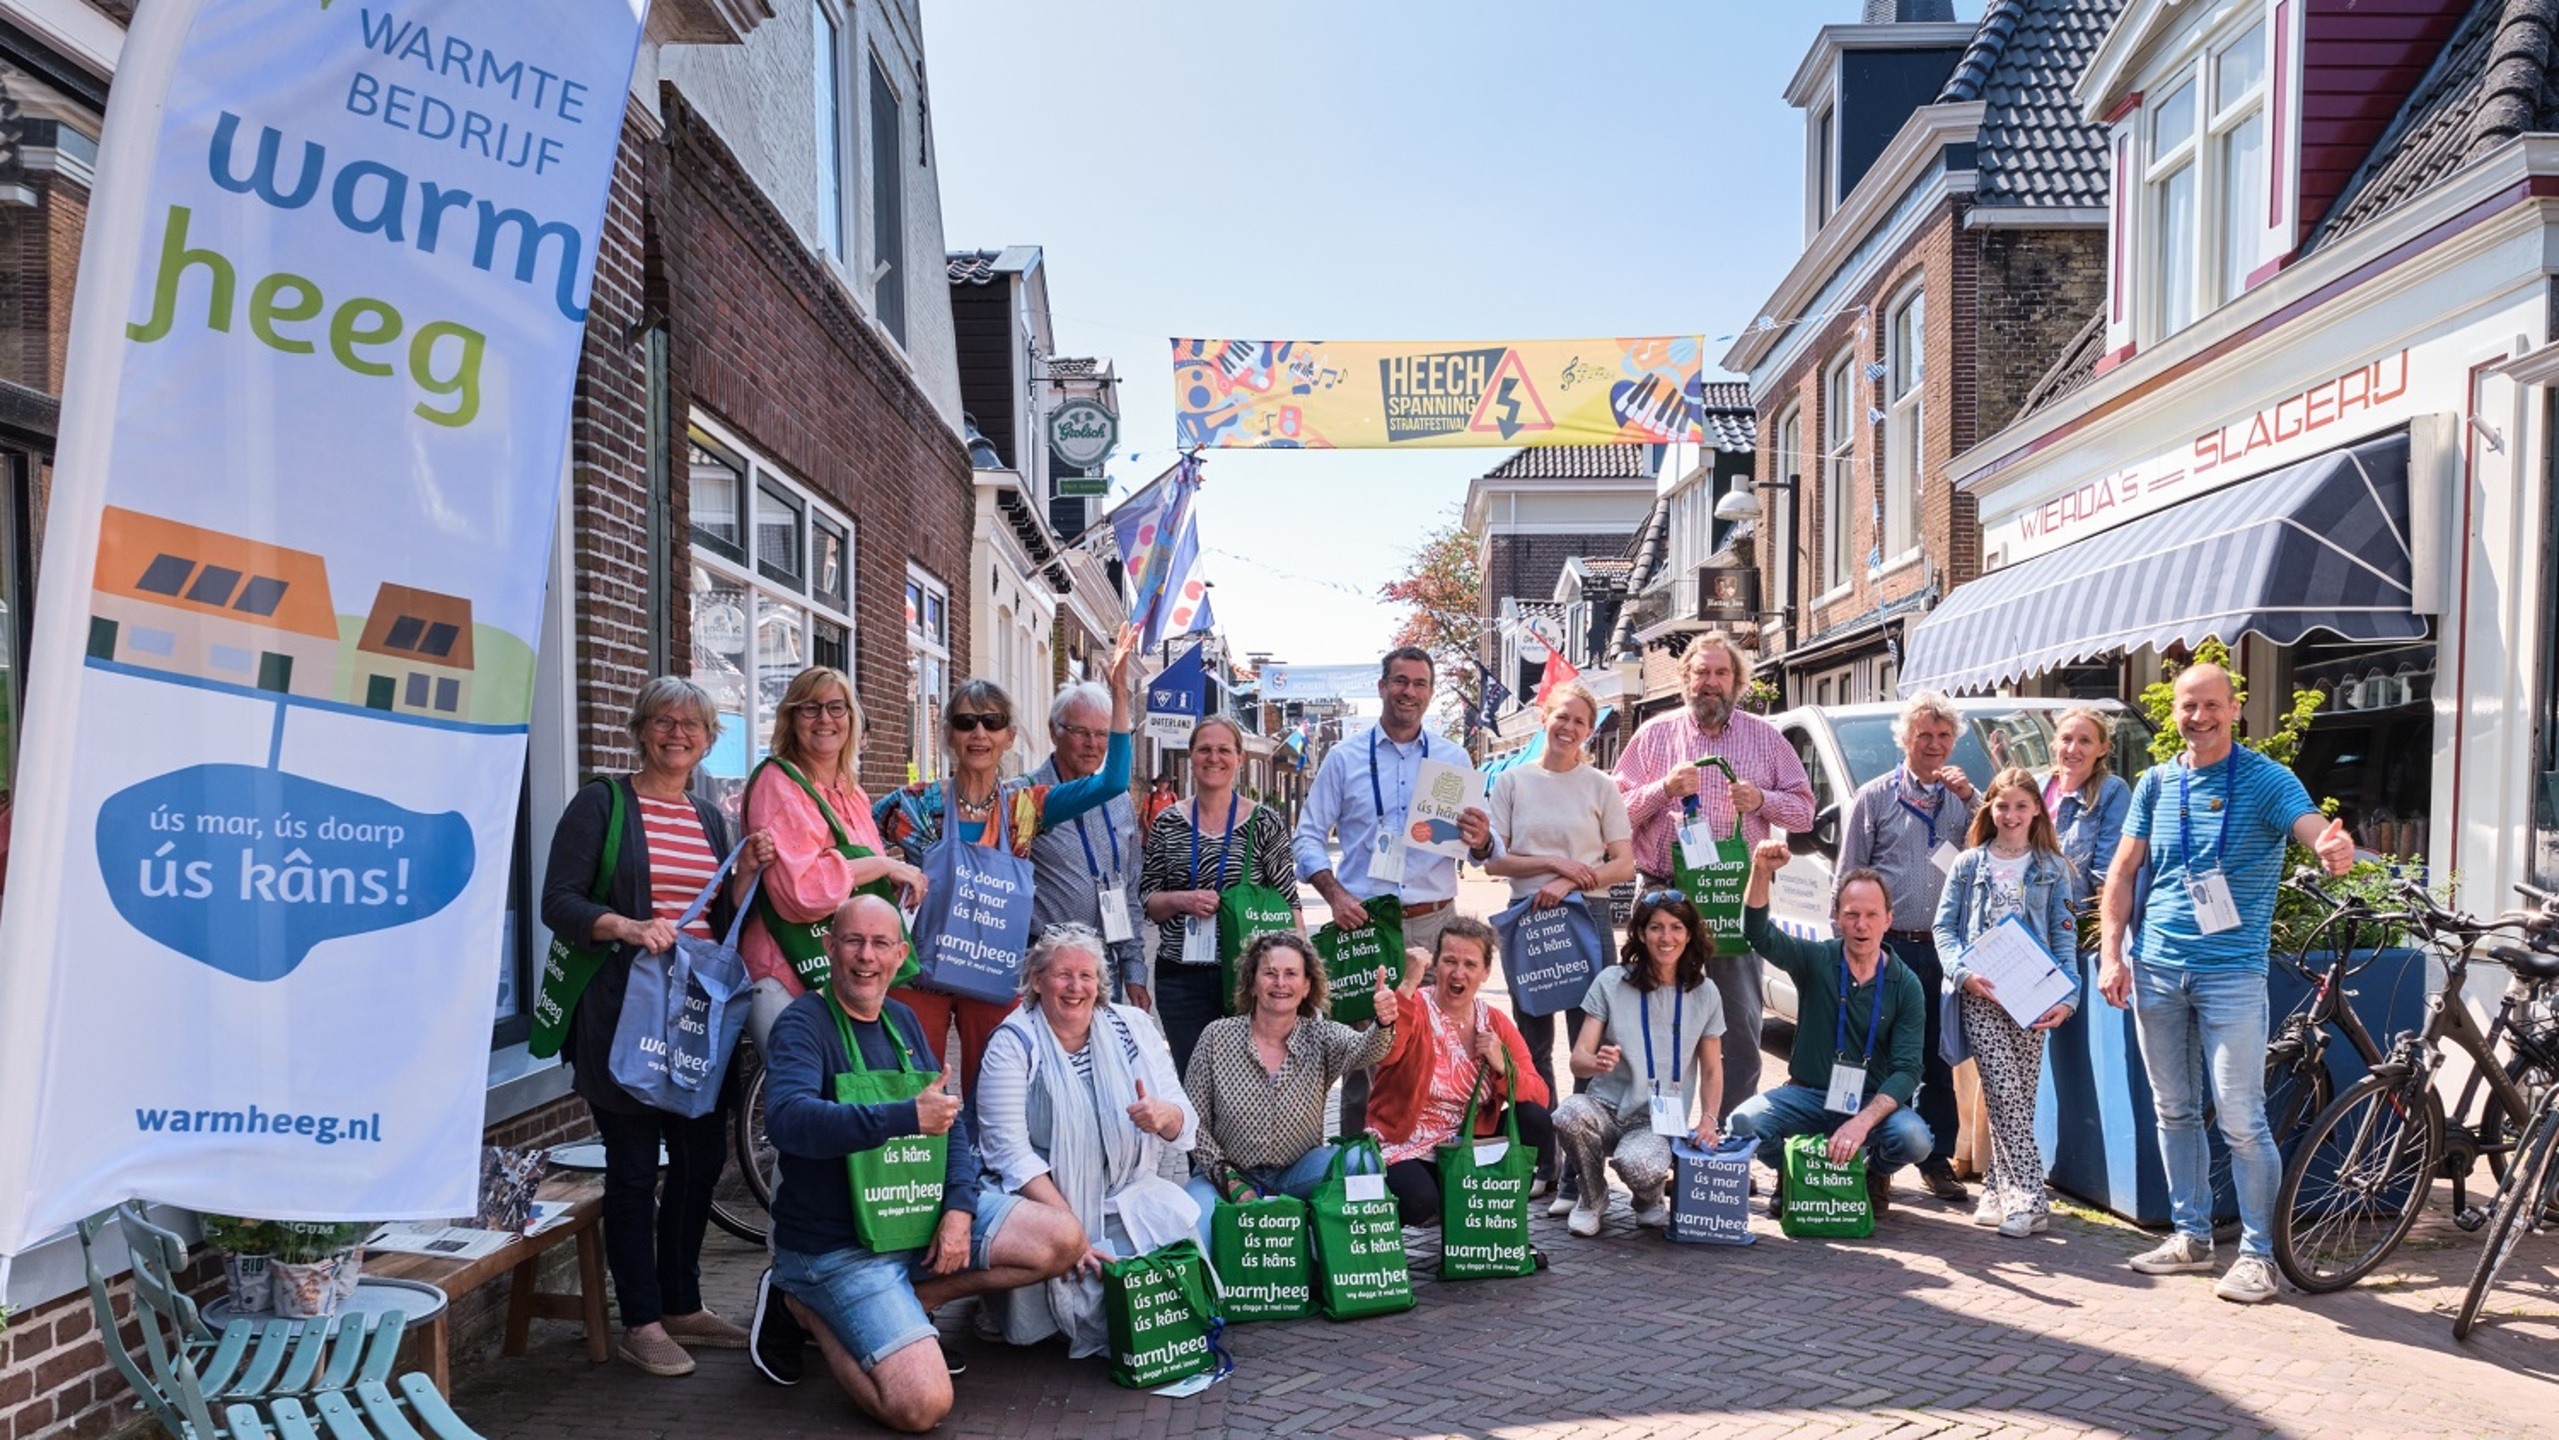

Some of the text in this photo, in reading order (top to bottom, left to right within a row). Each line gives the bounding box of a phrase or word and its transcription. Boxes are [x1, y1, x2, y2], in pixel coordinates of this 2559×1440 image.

[361, 8, 588, 124] WARMTE
[346, 72, 564, 175] BEDRIJF
[208, 110, 589, 322] warm
[125, 204, 487, 428] heeg
[1389, 355, 1486, 395] HEECH
[1388, 396, 1477, 416] SPANNING
[2193, 348, 2409, 474] SLAGERIJ
[1057, 421, 1107, 441] Grolsch
[1417, 799, 1432, 815] ús
[150, 803, 405, 850] ús mar, ús doarp
[139, 840, 410, 906] ús kâns!
[956, 864, 1016, 893] ús doarp
[1697, 875, 1739, 887] ús mar
[959, 883, 1008, 910] ús mar
[1695, 891, 1740, 904] ús kâns
[953, 903, 1007, 930] ús kâns
[1245, 907, 1292, 923] ús doarp
[1534, 907, 1568, 922] doarp
[810, 923, 829, 939] ús
[1337, 927, 1376, 945] ús mar
[1526, 923, 1566, 941] ús mar
[1337, 942, 1381, 962] ús kâns
[1528, 938, 1572, 957] ús kâns
[1516, 959, 1589, 986] warmheeg
[136, 1104, 382, 1145] warmheeg.nl
[884, 1145, 931, 1164] ús kâns
[1806, 1157, 1821, 1169] ús
[1708, 1158, 1746, 1174] doarp
[1463, 1175, 1521, 1193] ús doarp
[1694, 1172, 1740, 1189] ús mar
[1805, 1171, 1853, 1187] ús kâns
[864, 1179, 943, 1204] warmheeg
[1691, 1187, 1740, 1206] ús kâns
[1342, 1202, 1359, 1216] ús
[1468, 1194, 1516, 1210] ús mar
[1789, 1199, 1867, 1216] warmheeg
[1238, 1212, 1301, 1231] ús doarp
[1350, 1220, 1395, 1234] ús mar
[1465, 1213, 1518, 1229] ús kâns
[1245, 1233, 1295, 1248] ús mar
[1350, 1238, 1401, 1255] ús kâns
[241, 1258, 264, 1272] BIO
[1241, 1252, 1296, 1268] ús kâns
[1124, 1263, 1187, 1289] ús dop
[1134, 1293, 1151, 1310] ús
[1134, 1308, 1189, 1332] ús kâns
[1122, 1335, 1208, 1368] warmheeg
